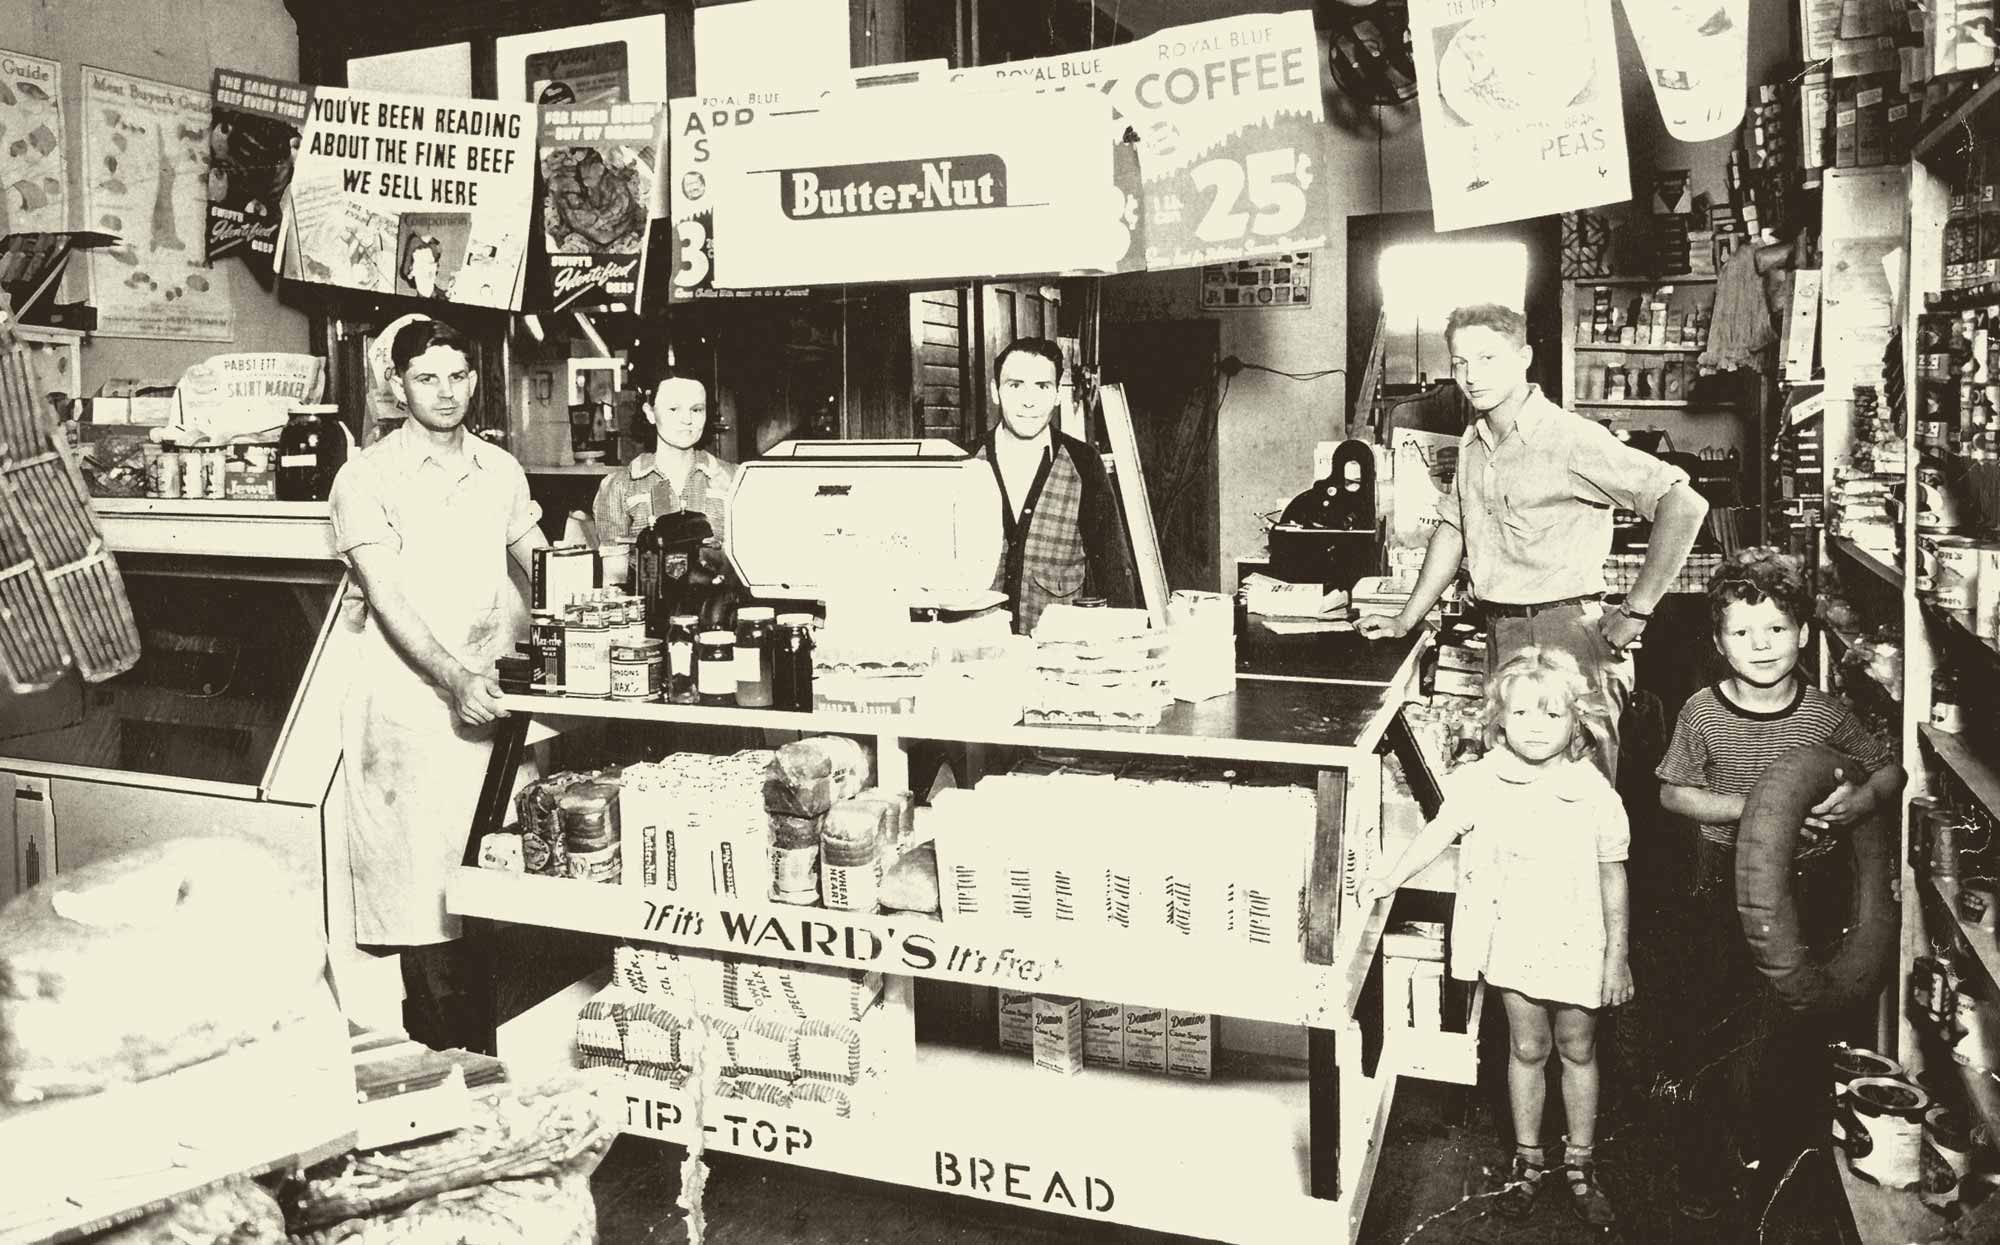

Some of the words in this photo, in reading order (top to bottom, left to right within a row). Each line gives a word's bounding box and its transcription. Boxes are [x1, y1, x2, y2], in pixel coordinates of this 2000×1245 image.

[1158, 37, 1218, 60] ROYAL
[1230, 27, 1273, 47] BLUE
[2, 60, 50, 83] Guide
[1062, 59, 1103, 77] BLUE
[1135, 47, 1305, 109] COFFEE
[314, 96, 370, 126] YOU'VE
[378, 104, 424, 131] BEEN
[435, 108, 521, 139] READING
[310, 132, 368, 161] ABOUT
[375, 138, 407, 165] THE
[415, 141, 457, 169] FINE
[466, 146, 516, 174] BEEF
[1541, 128, 1607, 161] PEAS
[342, 168, 371, 195] WE
[379, 173, 423, 201] SELL
[431, 178, 478, 206] HERE
[792, 161, 995, 217] Butter-Nut
[674, 220, 709, 288] 3
[553, 259, 638, 297] Identified
[829, 868, 841, 905] HEART
[837, 869, 849, 906] WHEAT
[720, 910, 938, 971] WARD'S
[946, 944, 988, 974] It's
[1086, 1005, 1119, 1020] Domino
[1127, 1009, 1162, 1025] Domino
[1170, 1013, 1206, 1028] Domino
[1143, 1028, 1164, 1038] Sugar
[1187, 1031, 1208, 1042] Sugar
[935, 1150, 1115, 1213] BREAD
